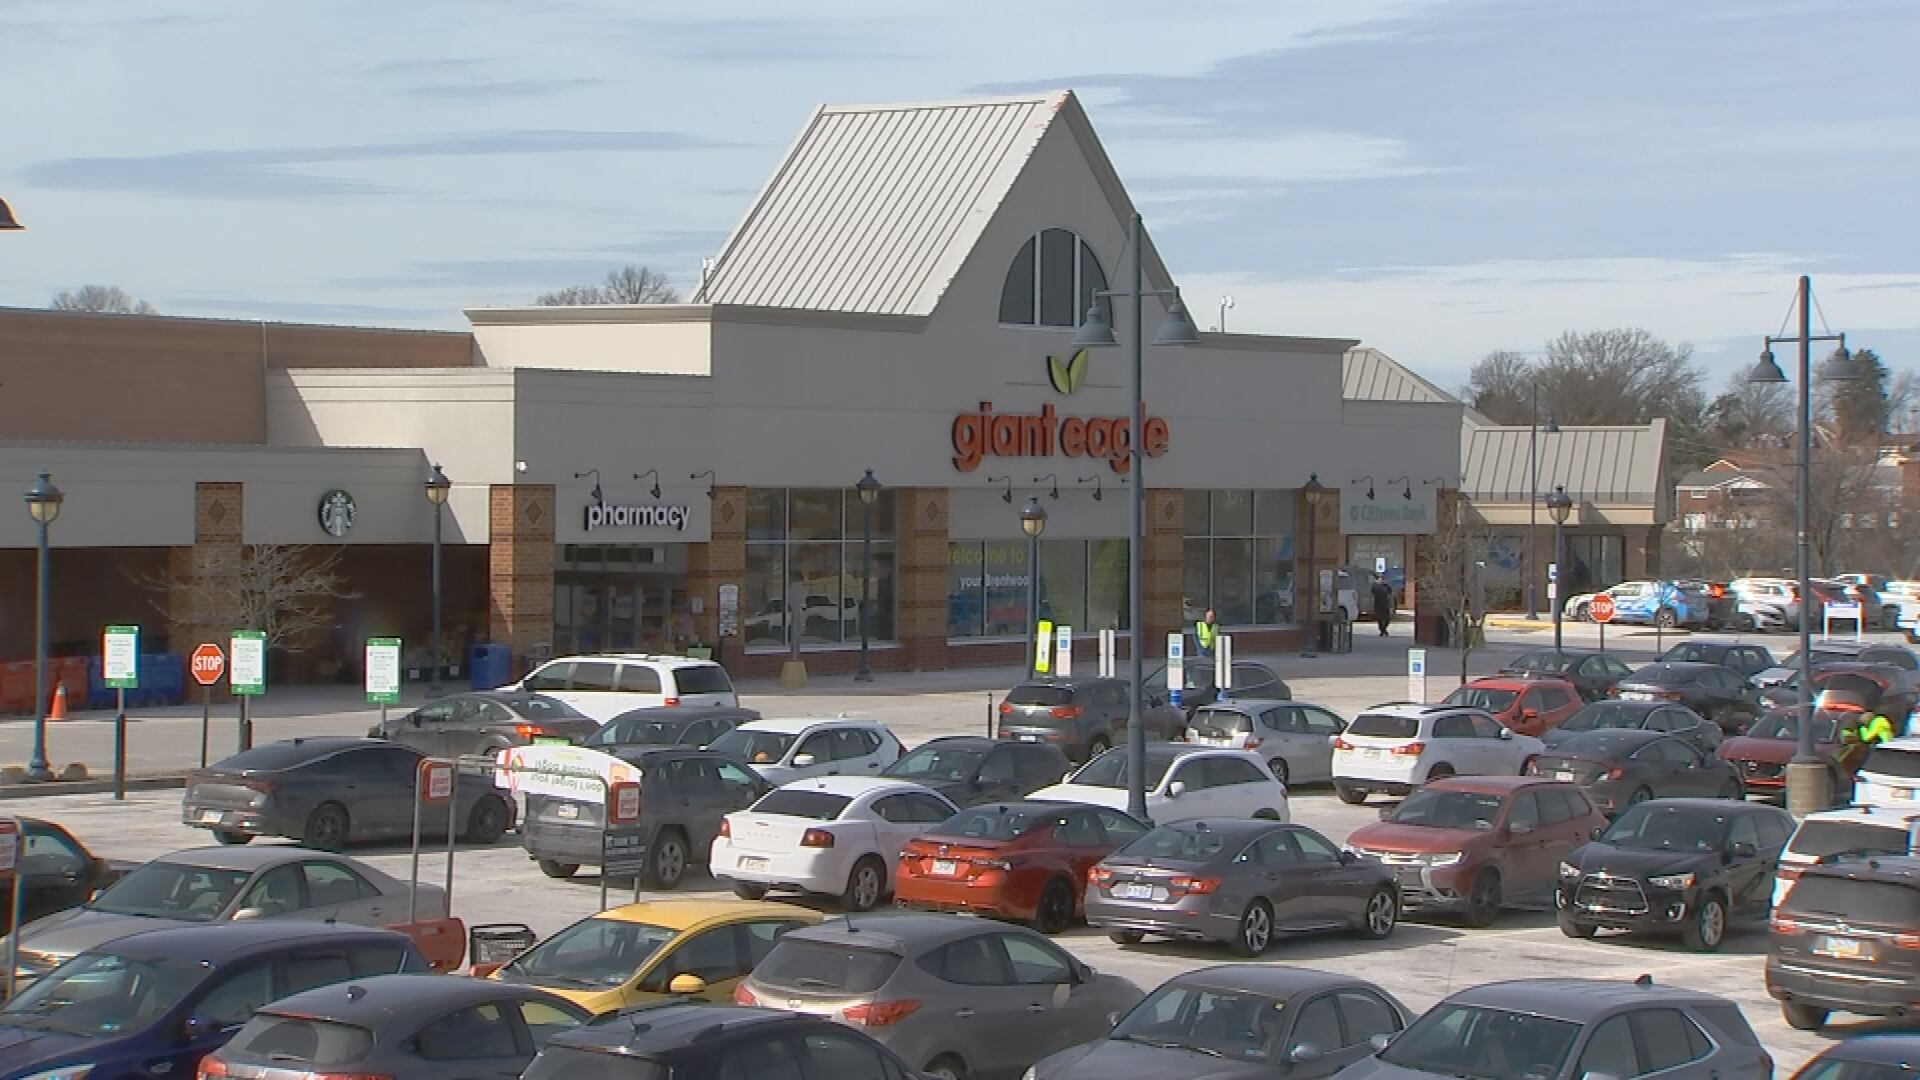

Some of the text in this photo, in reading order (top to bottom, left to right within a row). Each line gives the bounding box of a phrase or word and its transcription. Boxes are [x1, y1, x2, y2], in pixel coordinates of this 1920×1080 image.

[952, 402, 1057, 472] giant
[586, 501, 691, 531] pharmacy
[960, 573, 1030, 591] your Brentwoo
[1590, 601, 1614, 614] STOP
[195, 655, 223, 671] STOP
